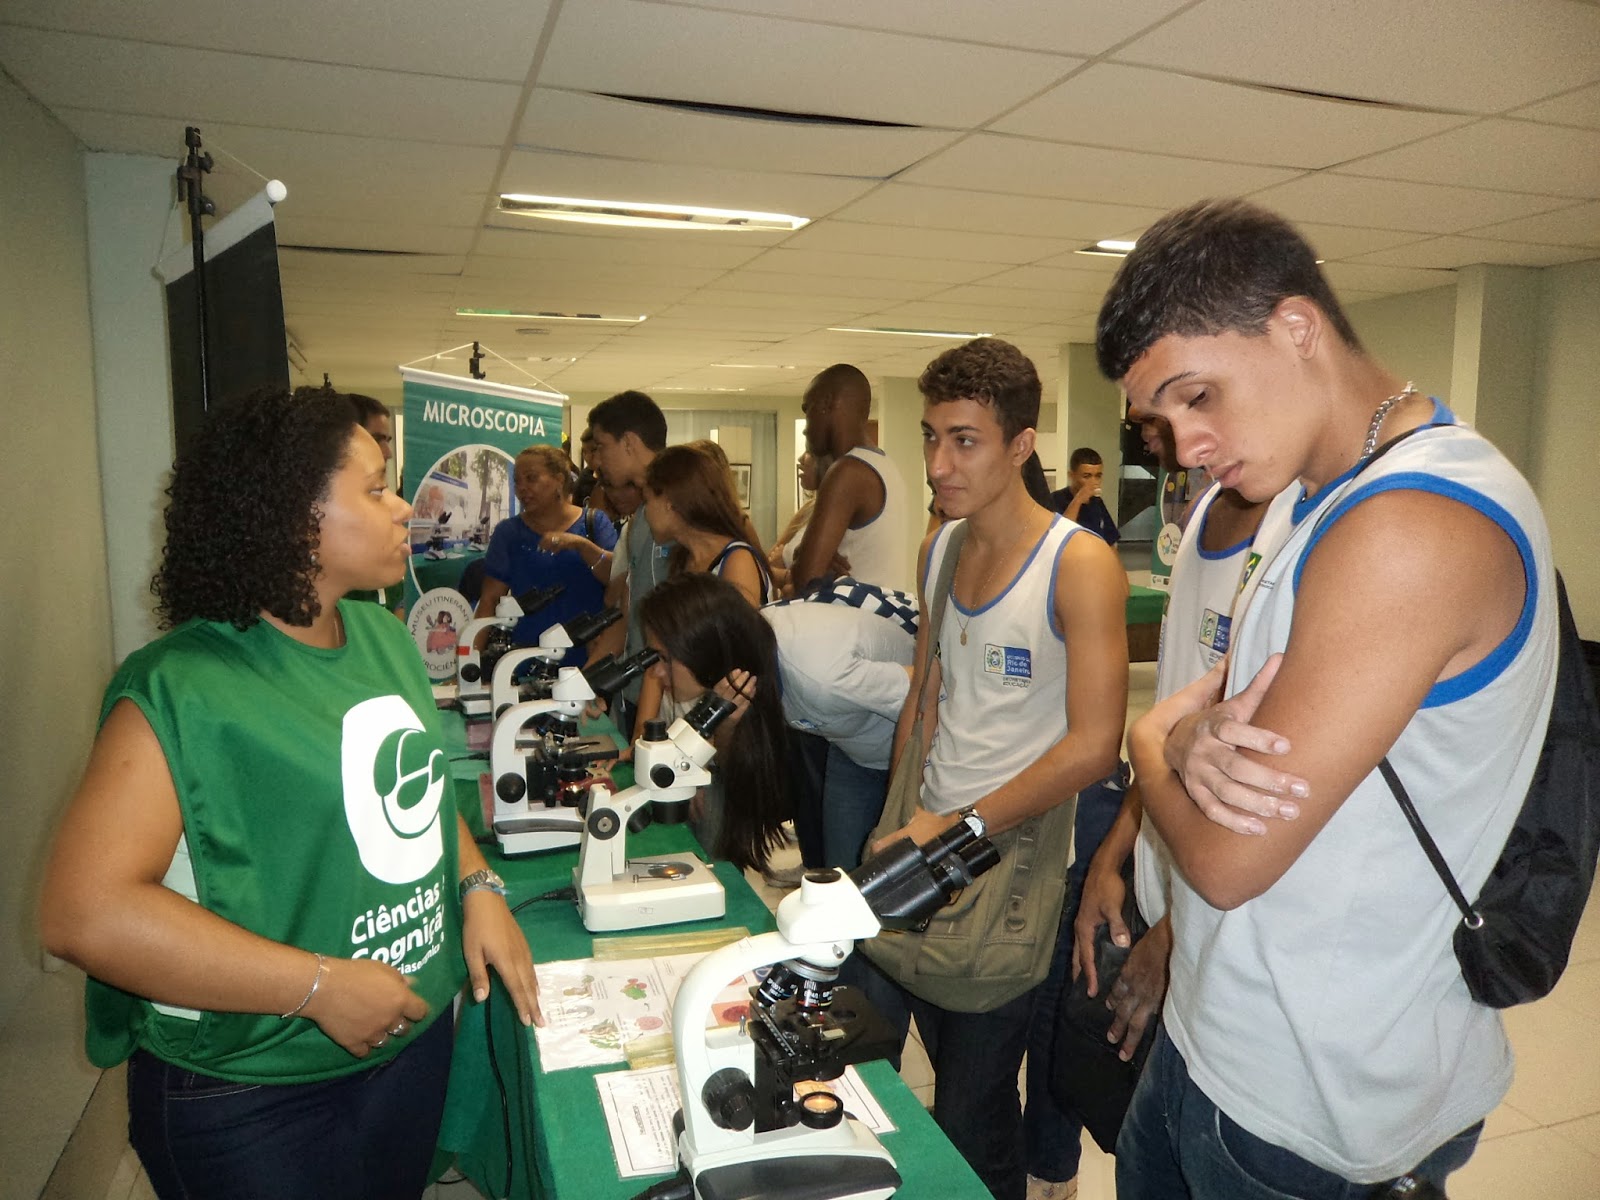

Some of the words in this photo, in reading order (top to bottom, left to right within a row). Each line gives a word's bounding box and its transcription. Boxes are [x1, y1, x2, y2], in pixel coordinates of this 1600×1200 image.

[423, 400, 545, 437] MICROSCOPIA
[411, 600, 433, 636] MUSEU
[434, 596, 470, 622] ITINERANT
[351, 882, 439, 944] Ciências
